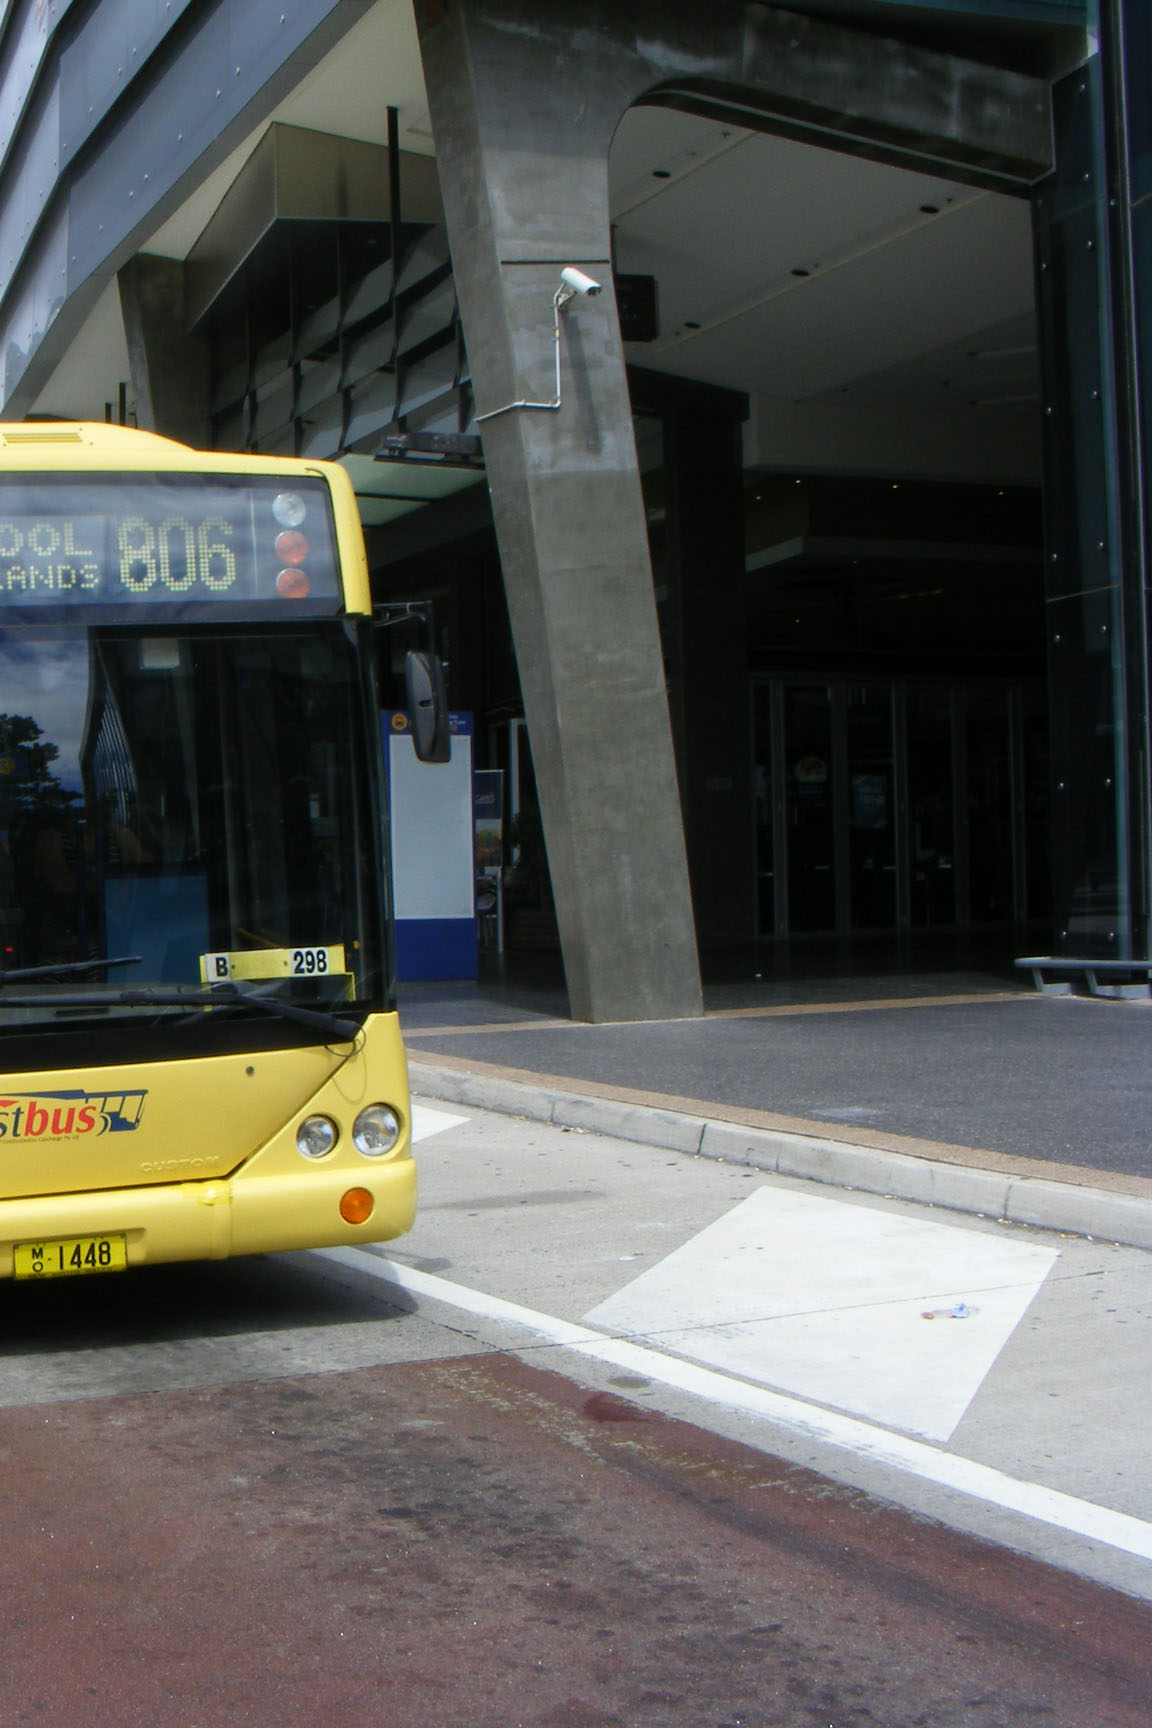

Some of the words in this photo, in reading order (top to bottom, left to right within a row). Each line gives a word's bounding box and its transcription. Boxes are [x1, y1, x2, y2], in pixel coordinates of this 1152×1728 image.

[118, 517, 236, 592] 806
[216, 957, 228, 977] B
[294, 950, 327, 974] 298
